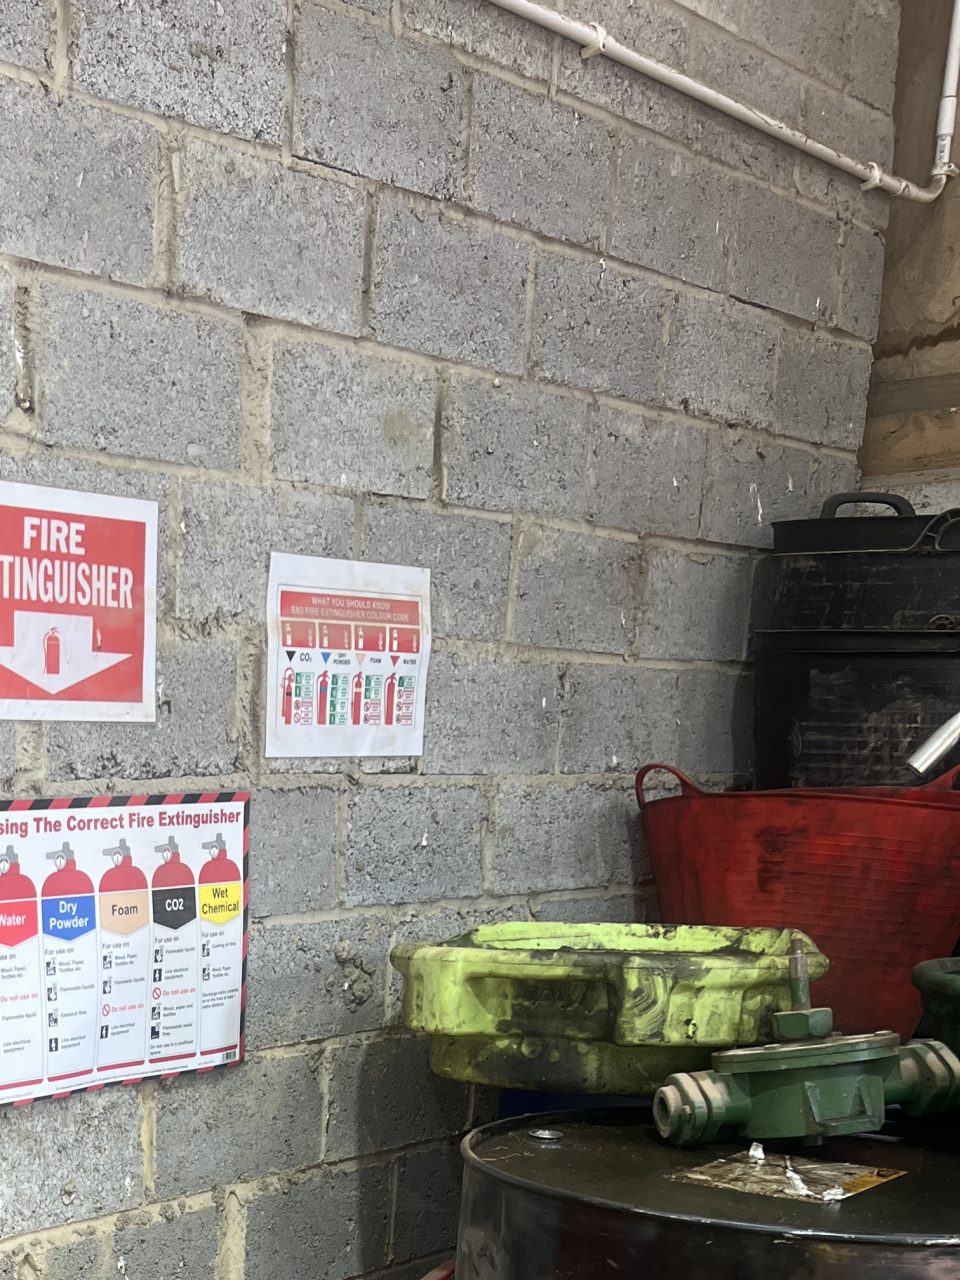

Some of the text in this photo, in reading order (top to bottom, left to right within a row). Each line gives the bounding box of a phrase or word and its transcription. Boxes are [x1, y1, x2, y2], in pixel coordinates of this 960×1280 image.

[24, 516, 86, 555] FIRE
[312, 597, 390, 610] WHAT YOU SHOULD KNOW
[305, 607, 319, 616] FIRE
[321, 609, 366, 619] EXTINGUISHER
[367, 611, 391, 620] COLOUR
[33, 816, 62, 833] The
[67, 814, 124, 831] Correct
[129, 812, 154, 828] Fire
[159, 809, 241, 828] Extinguisher
[212, 888, 228, 899] Wet
[59, 901, 77, 914] Dry
[112, 904, 138, 916] Foam
[165, 898, 184, 911] CO2
[202, 900, 239, 914] Chemical
[50, 916, 89, 930] Powder
